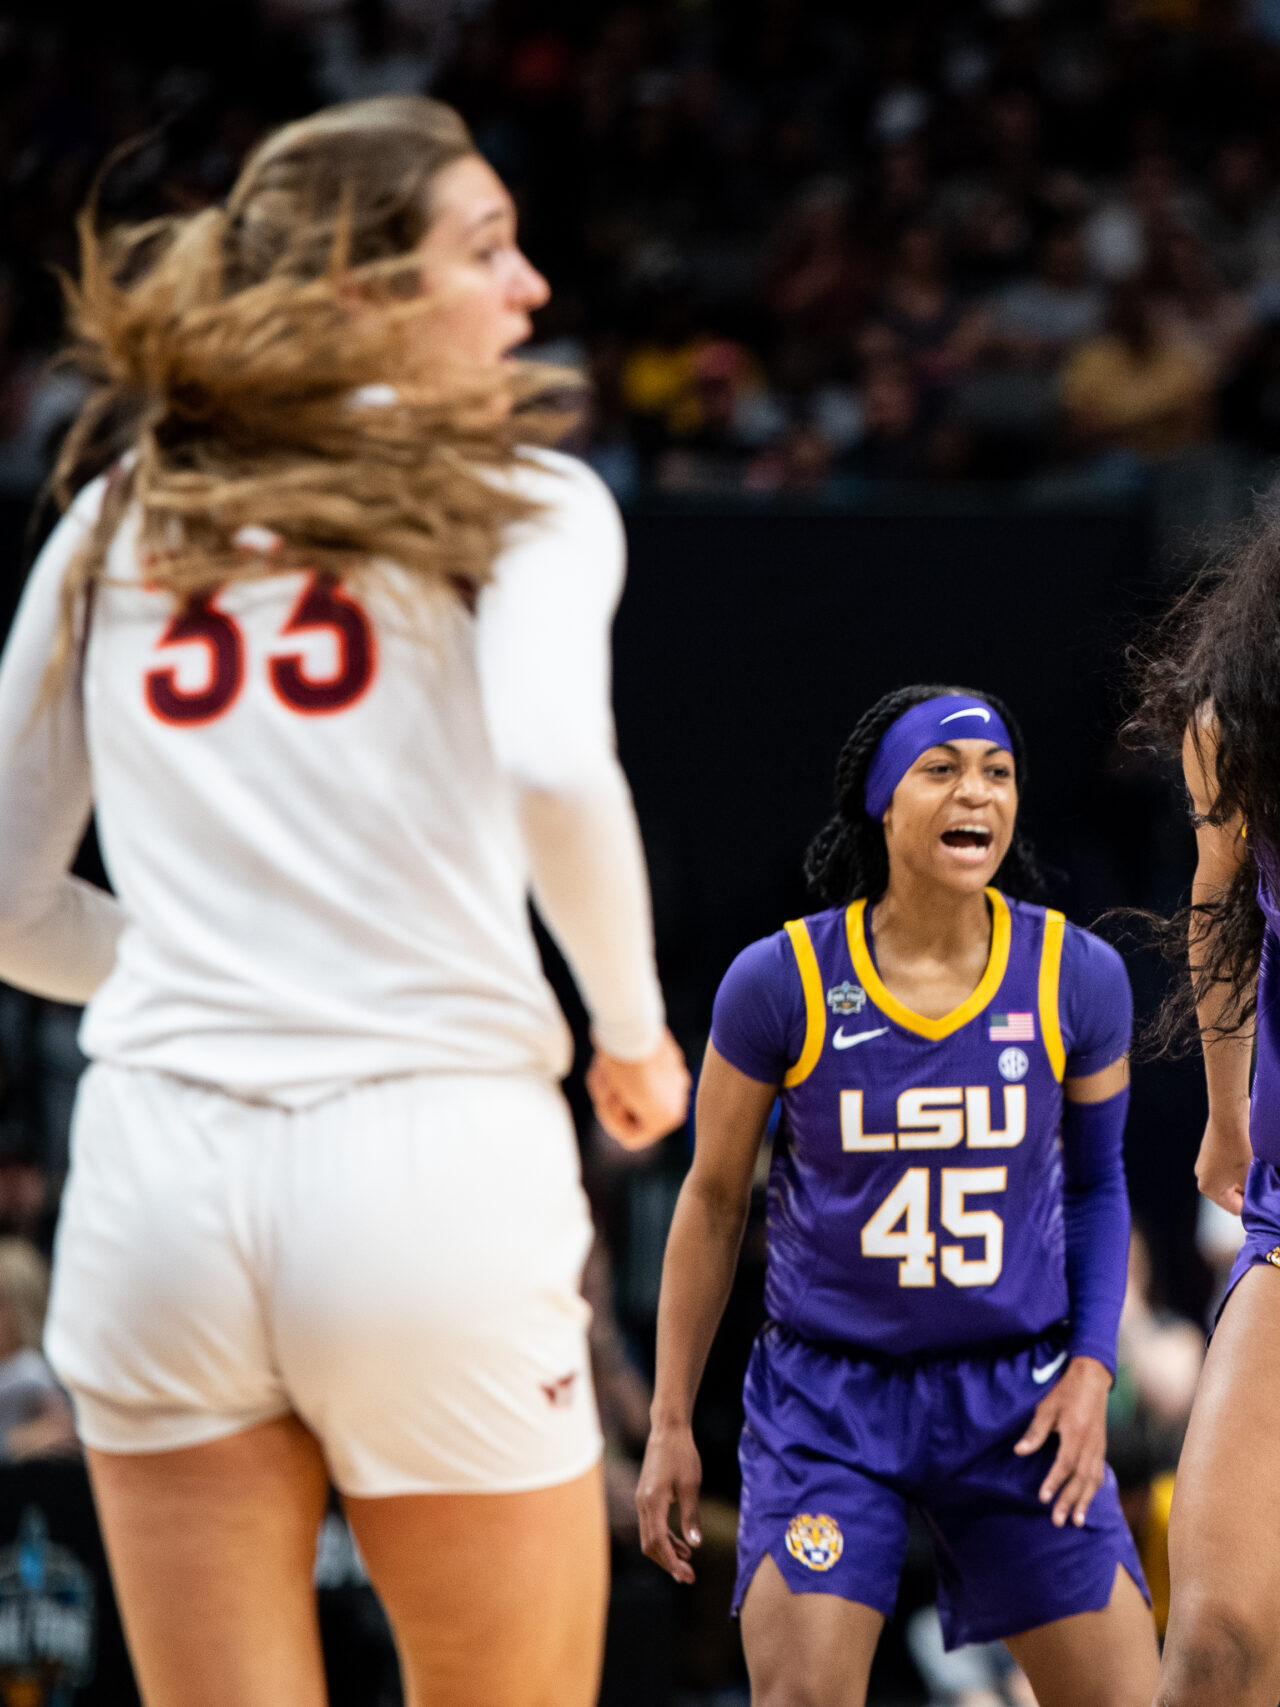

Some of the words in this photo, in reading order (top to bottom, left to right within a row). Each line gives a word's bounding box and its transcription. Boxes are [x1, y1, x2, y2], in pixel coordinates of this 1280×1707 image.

[143, 560, 379, 730] 33
[840, 1084, 1026, 1152] LSU
[861, 1166, 1007, 1288] 45
